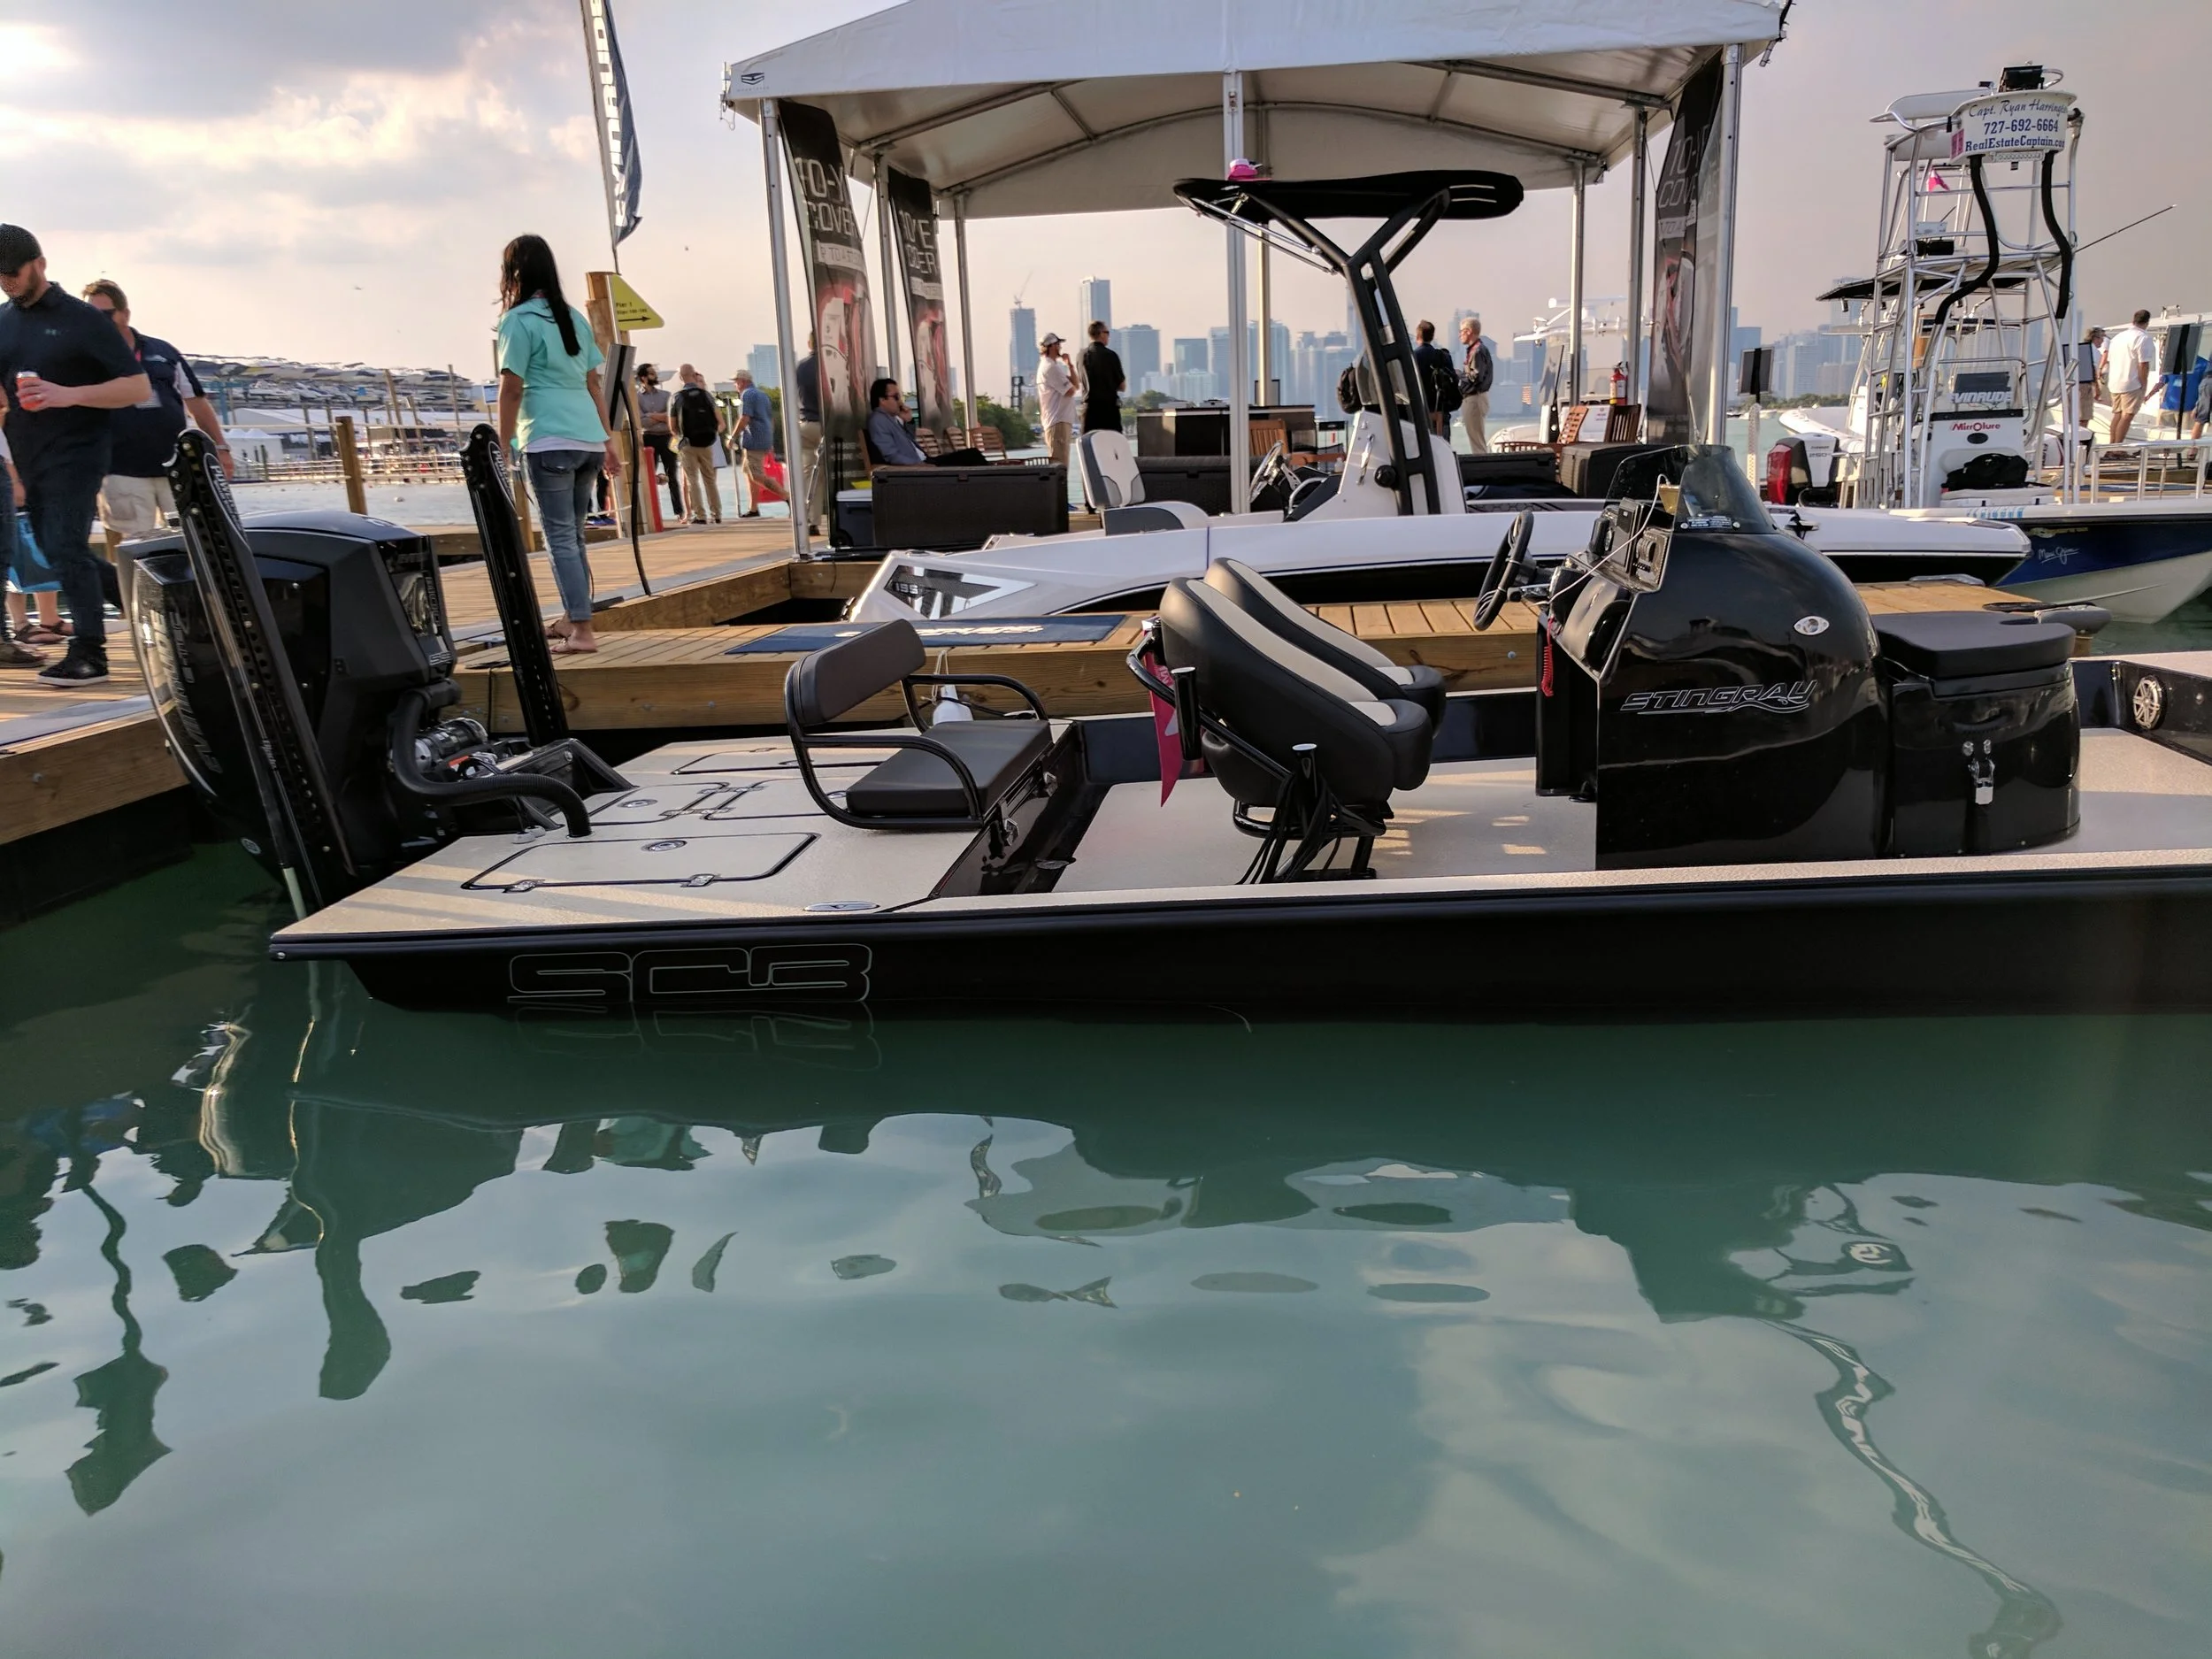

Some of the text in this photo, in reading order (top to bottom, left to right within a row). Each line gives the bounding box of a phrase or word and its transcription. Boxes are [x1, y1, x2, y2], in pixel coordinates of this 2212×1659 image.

[1969, 104, 1996, 120] Capt.
[2000, 100, 2026, 116] Ryan
[1984, 119, 2058, 134] 727-692-6664
[1620, 680, 1817, 711] STINGRAY
[507, 943, 872, 1002] SCB
